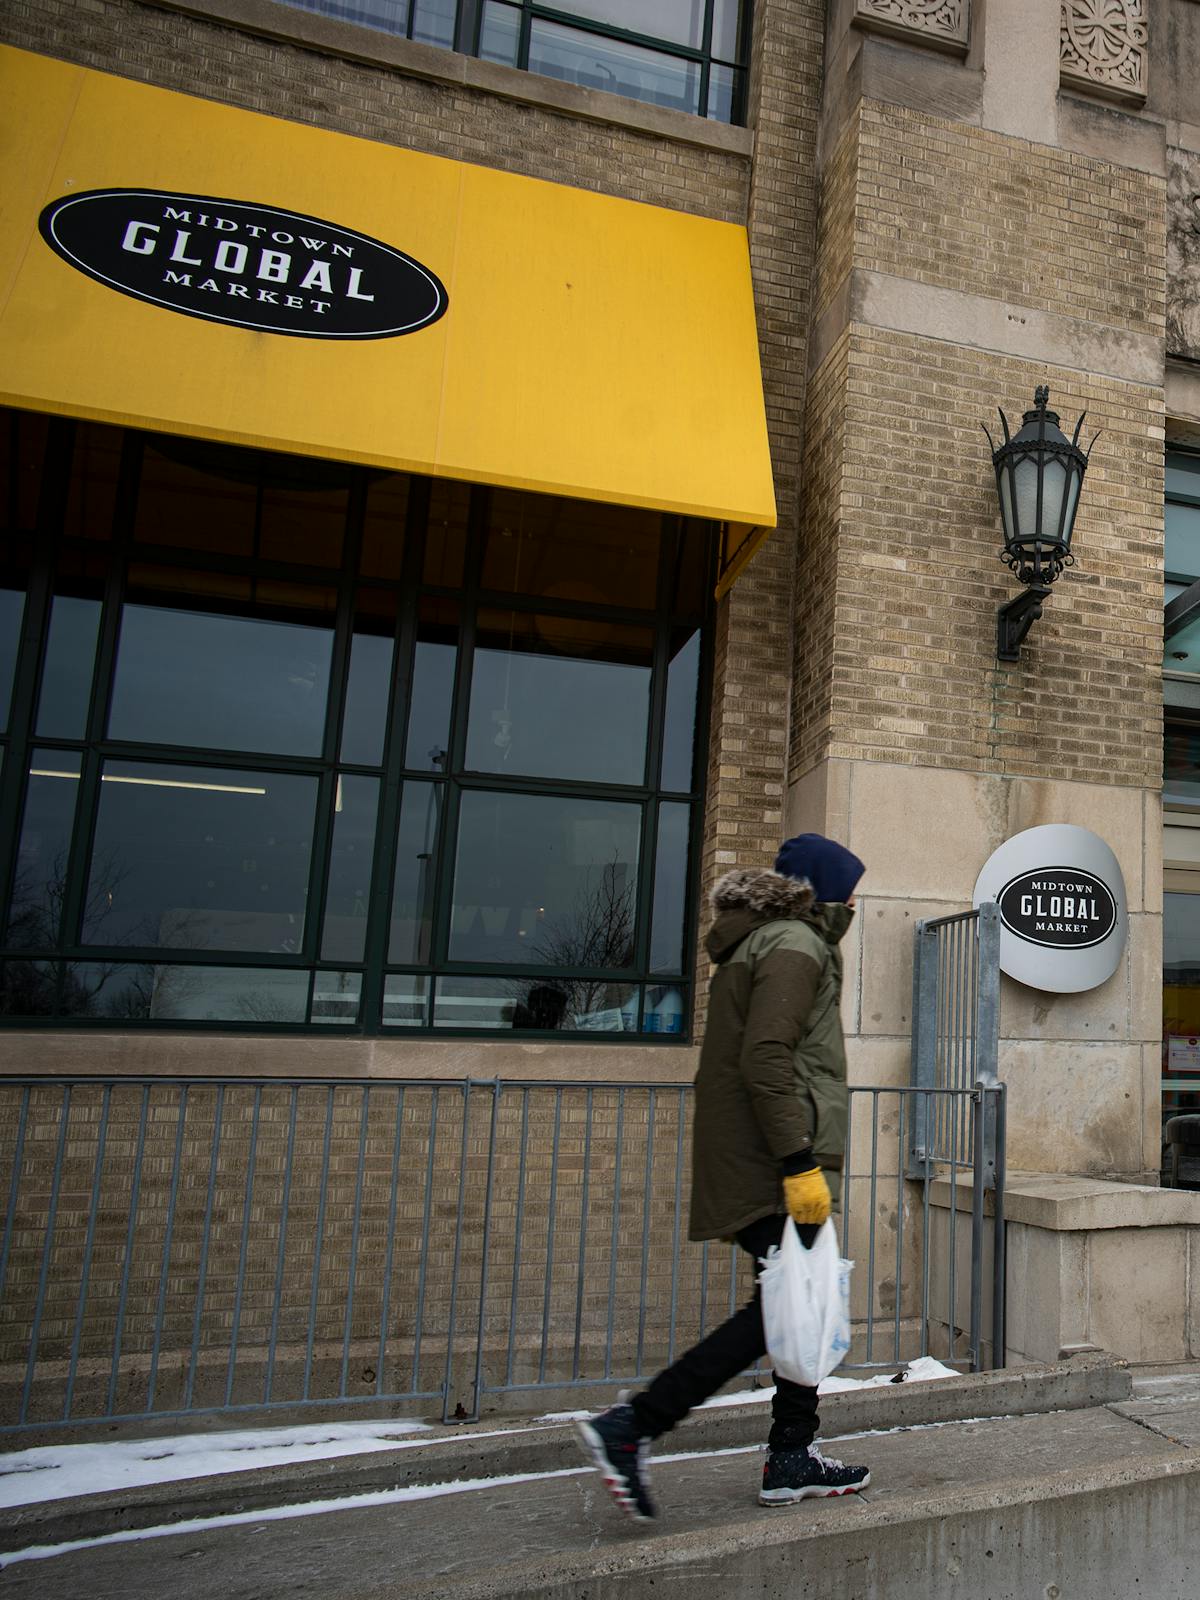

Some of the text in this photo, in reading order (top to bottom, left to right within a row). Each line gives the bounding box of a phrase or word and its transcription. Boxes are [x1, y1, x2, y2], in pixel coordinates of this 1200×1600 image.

[162, 206, 355, 258] MIDTOWN
[121, 220, 375, 302] GLOBAL
[162, 270, 333, 315] MARKET
[1031, 881, 1093, 894] MIDTOWN
[1020, 894, 1100, 921] GLOBAL
[1035, 922, 1089, 934] MARKET
